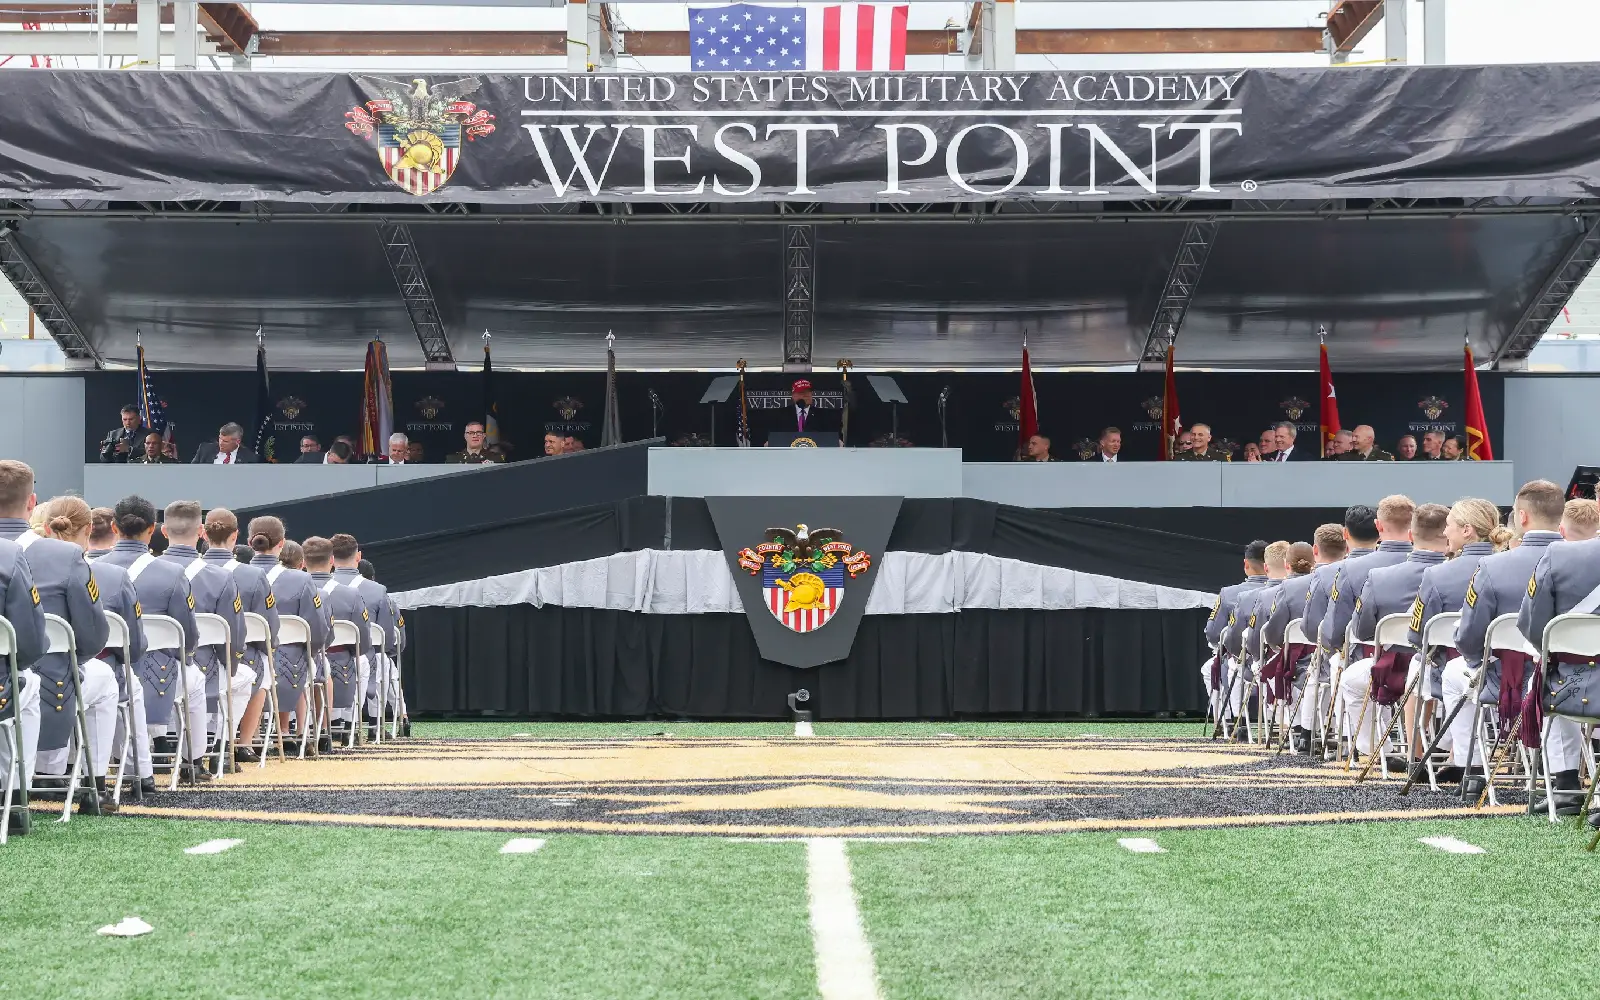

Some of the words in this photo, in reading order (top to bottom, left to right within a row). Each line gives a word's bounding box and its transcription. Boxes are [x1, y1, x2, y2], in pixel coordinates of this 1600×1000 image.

[521, 76, 676, 102] UNITED
[692, 76, 830, 102] STATES
[846, 75, 1031, 102] MILITARY
[1046, 75, 1242, 102] ACADEMY
[521, 122, 840, 198] WEST
[875, 122, 1243, 195] POINT
[746, 397, 792, 409] WEST
[1408, 424, 1430, 432] WEST
